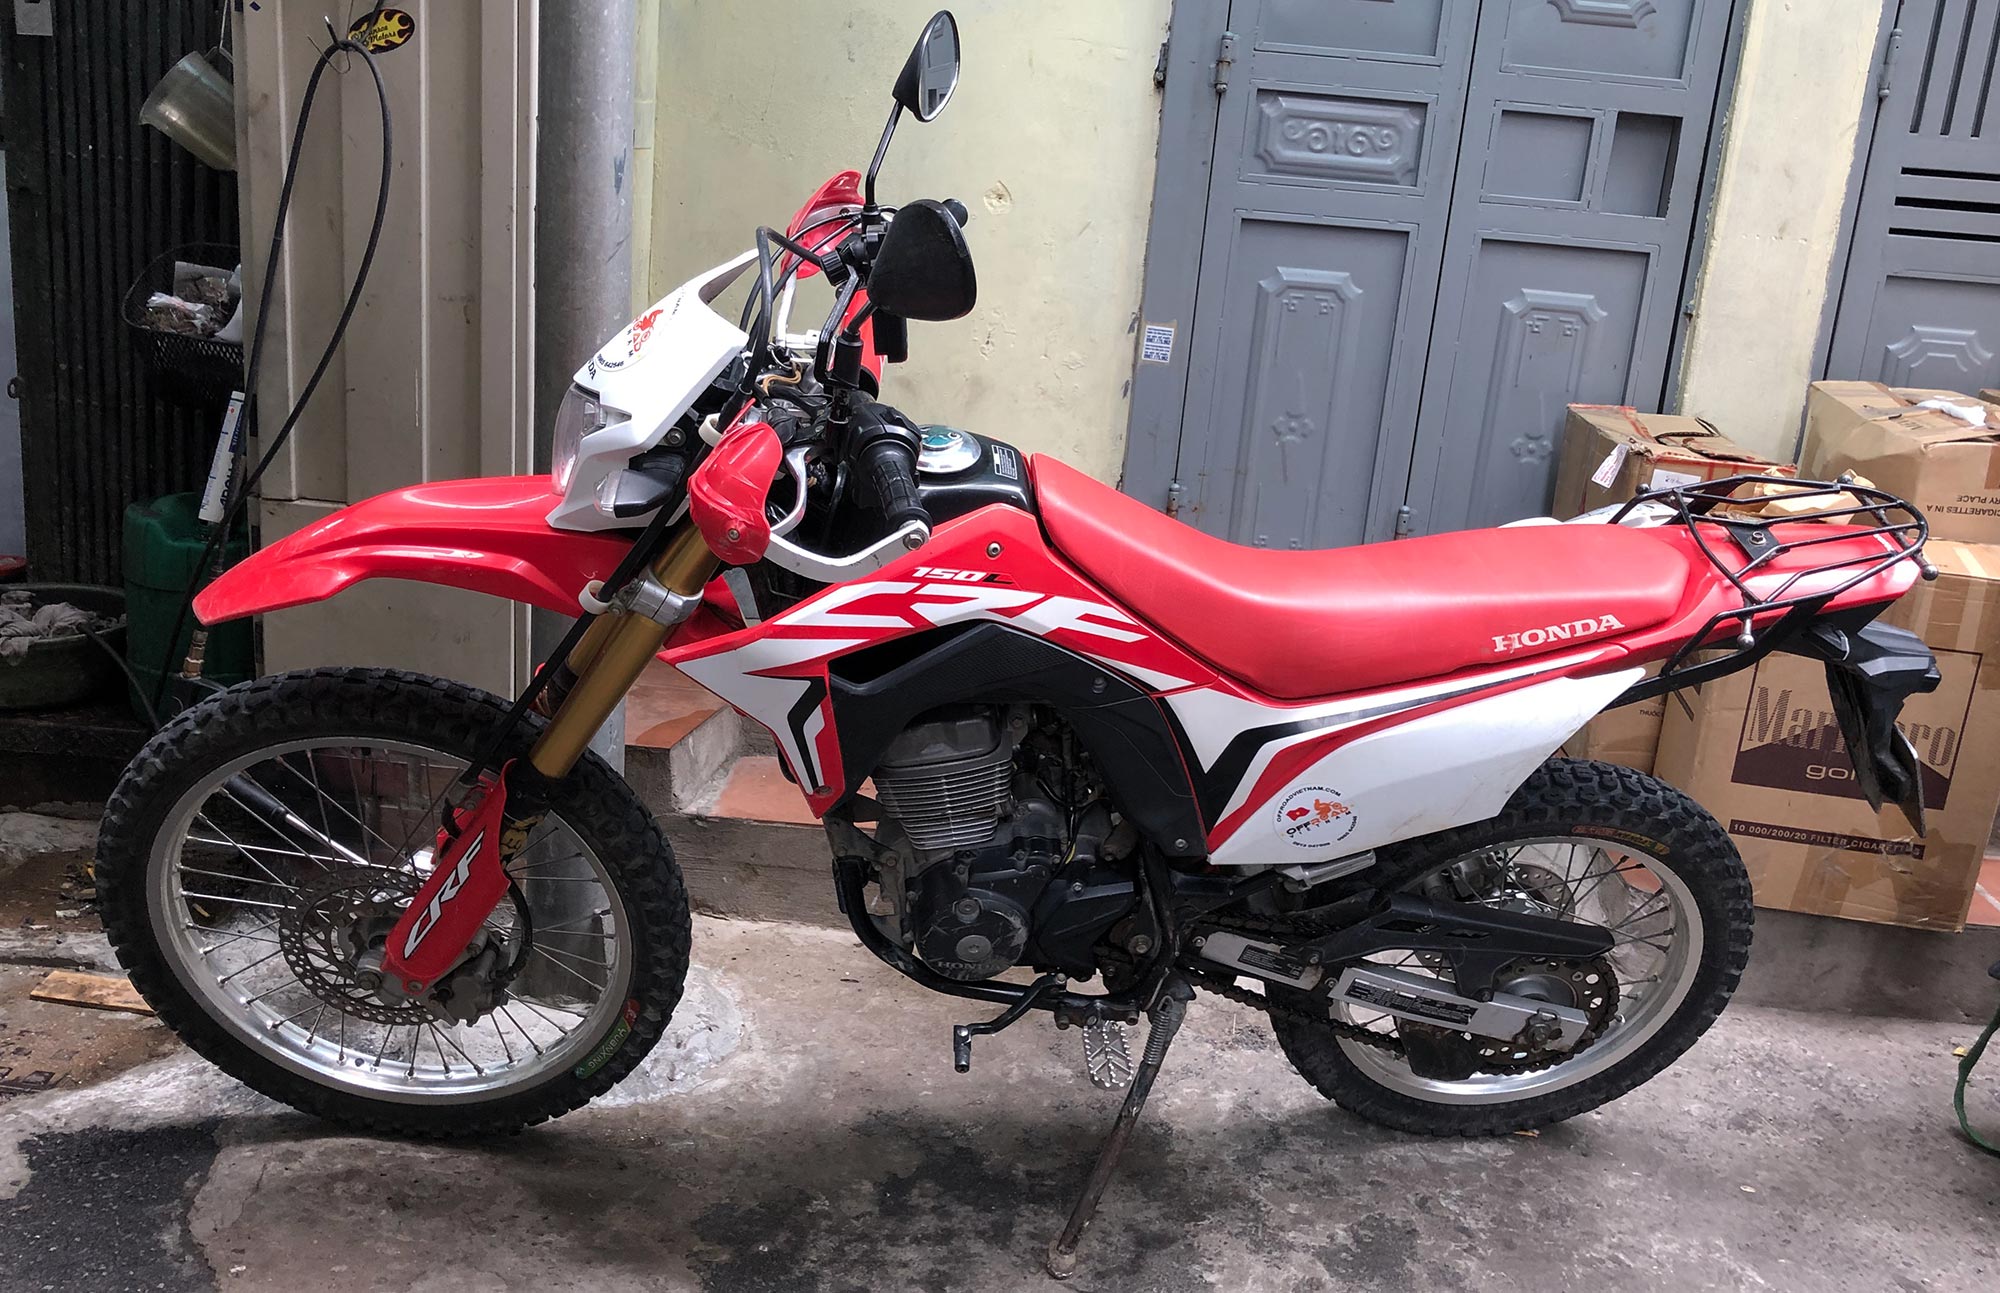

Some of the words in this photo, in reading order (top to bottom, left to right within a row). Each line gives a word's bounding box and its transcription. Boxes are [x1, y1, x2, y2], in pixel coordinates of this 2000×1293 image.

[1926, 504, 1933, 512] A
[1934, 505, 1944, 513] IN
[1957, 494, 1986, 504] PLACE
[1491, 614, 1625, 653] HONDA
[1747, 686, 1956, 767] Marro
[1805, 763, 1856, 781] gol
[1276, 786, 1341, 822] OFFROADVIETNAM.COM
[1733, 823, 1746, 833] 10
[1748, 826, 1807, 842] 000/200/20
[1810, 834, 1847, 848] FILTER
[404, 828, 485, 960] CRF
